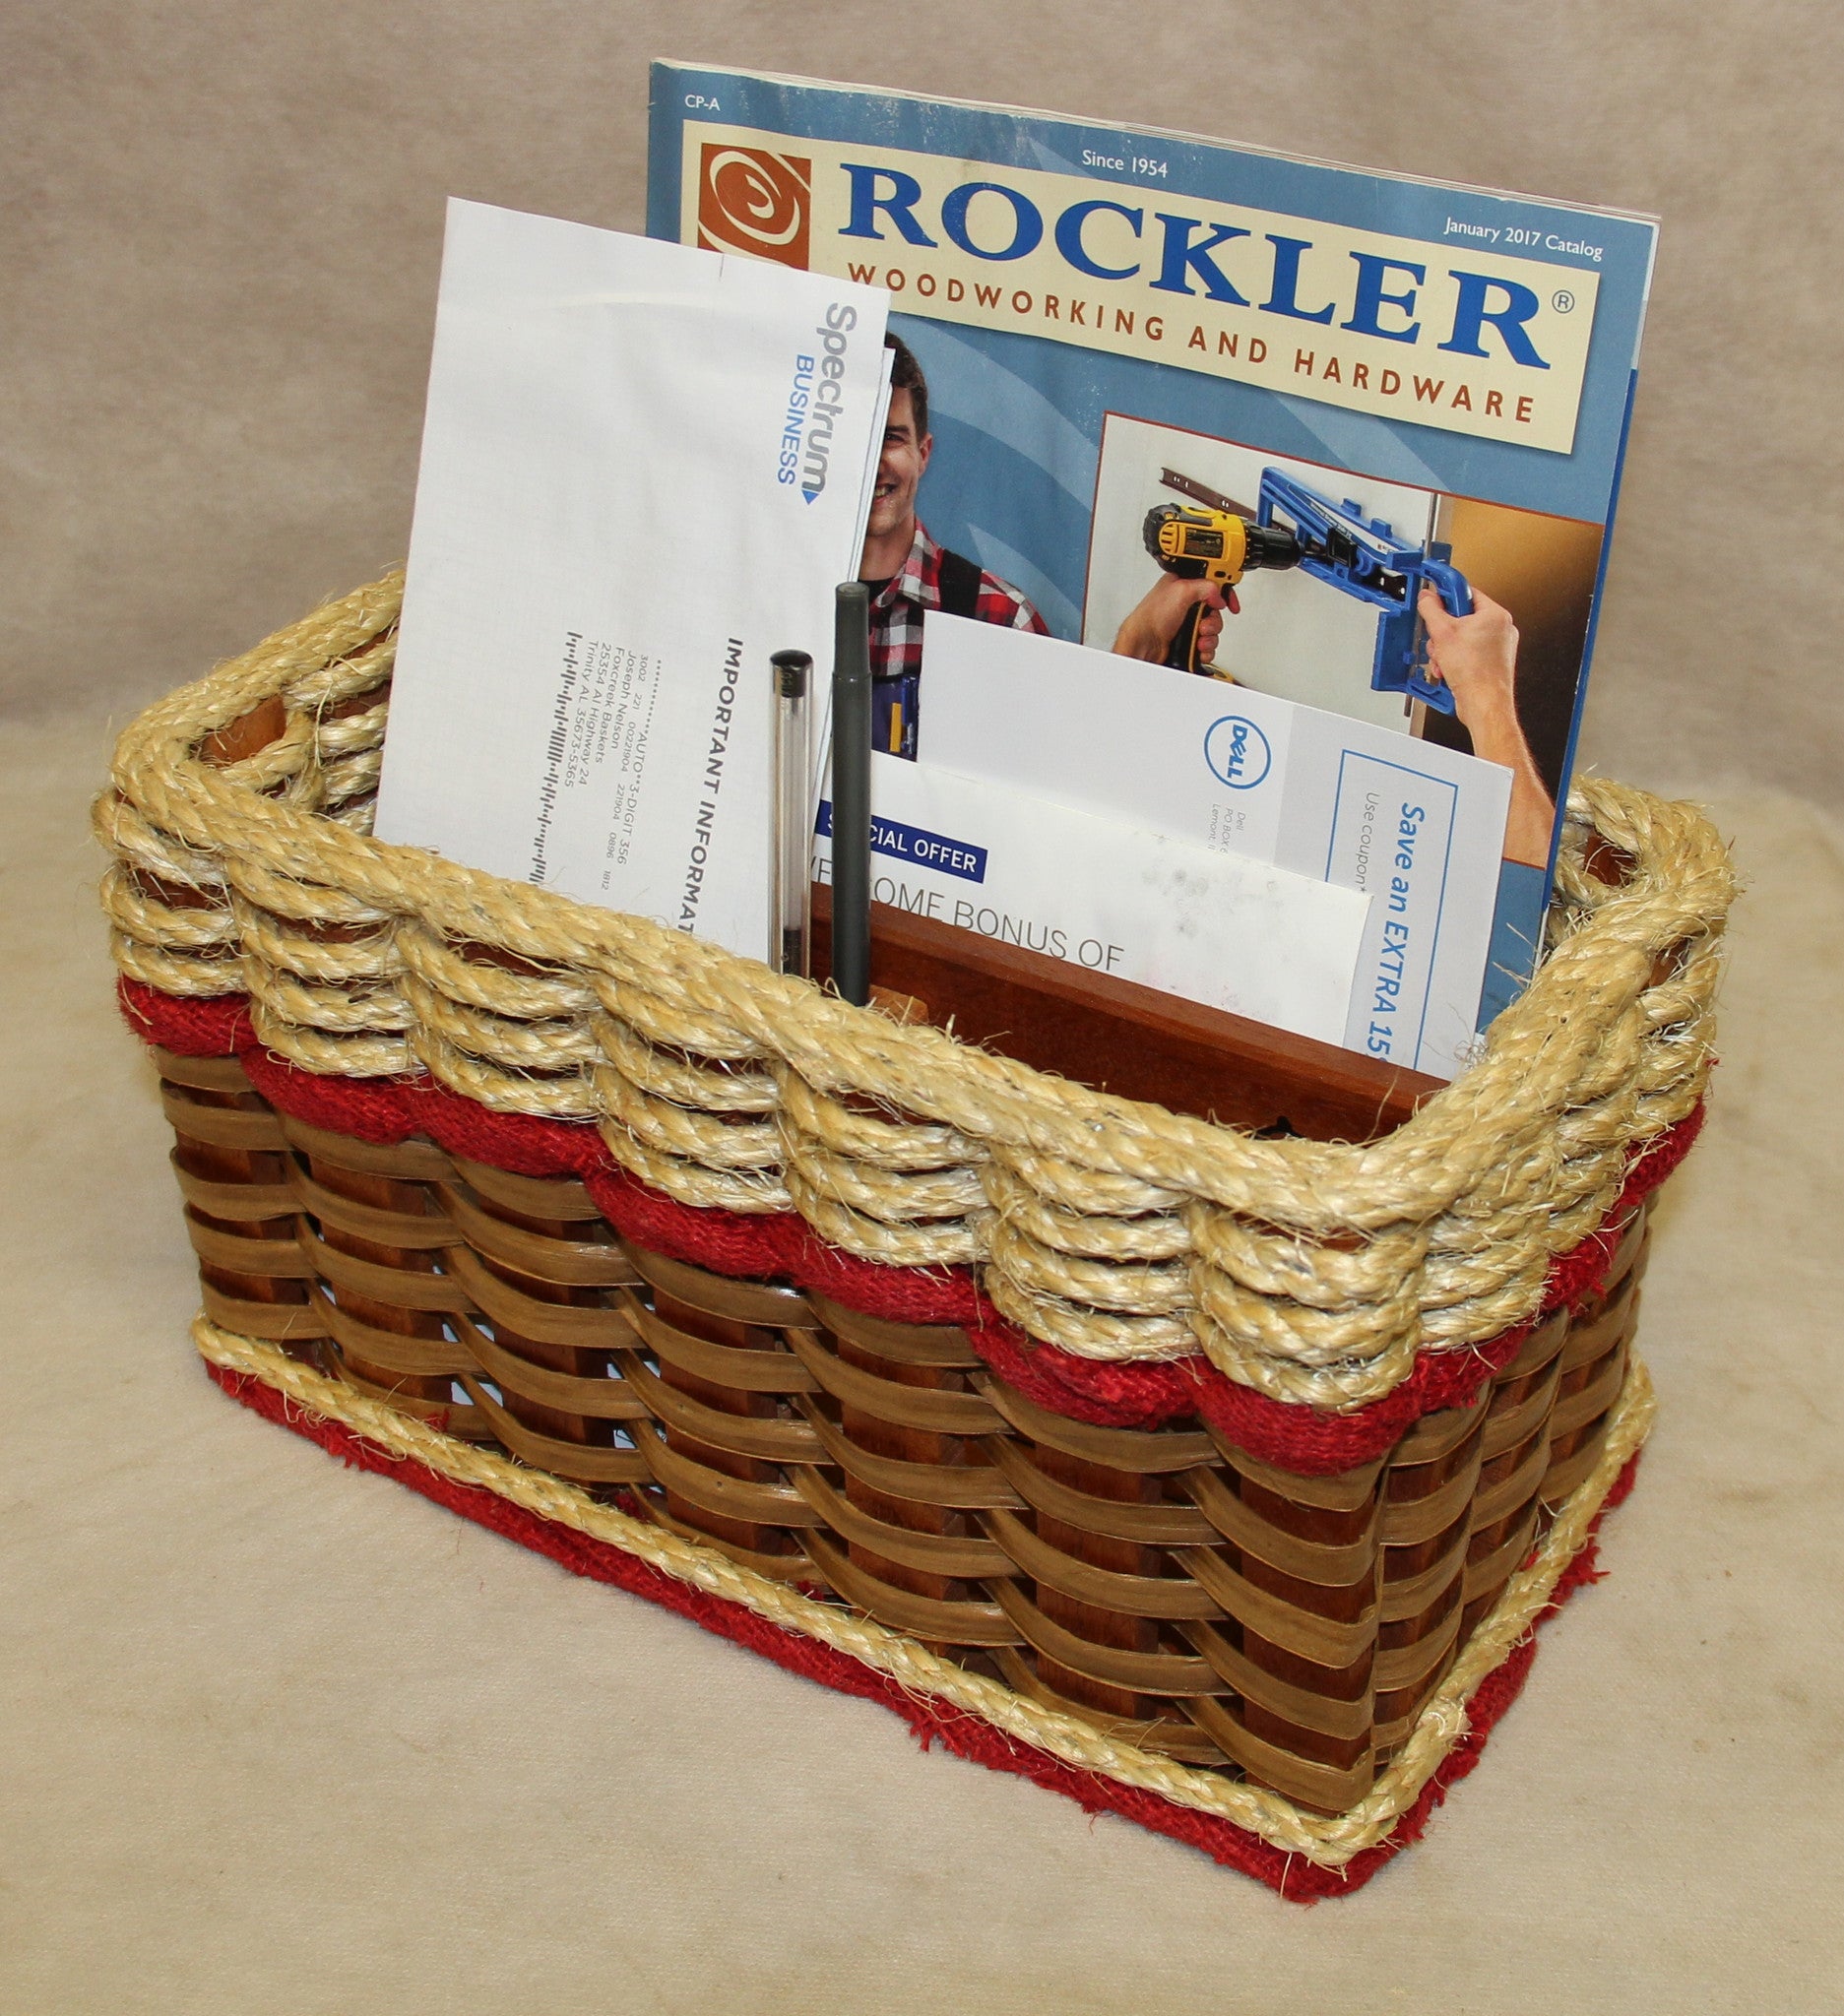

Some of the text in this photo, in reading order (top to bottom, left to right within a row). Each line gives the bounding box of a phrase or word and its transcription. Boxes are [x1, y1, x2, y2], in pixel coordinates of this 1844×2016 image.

[684, 94, 721, 111] CP-A
[1081, 150, 1169, 178] Since 1954
[1443, 217, 1604, 263] January 2017 Catalog
[838, 162, 1552, 370] ROCKLER
[847, 262, 1534, 423] WOODWORKING AND HARDWARE
[778, 354, 815, 485] BUSINESS
[800, 303, 858, 492] Spectrum
[596, 642, 611, 685] 25354
[638, 654, 649, 682] 3002
[564, 641, 600, 788] Trinity AL 35673-5365
[595, 647, 626, 764] Foxcreek Baskets
[610, 650, 637, 749] Joseph Nelson
[632, 692, 642, 710] 221
[704, 638, 744, 794] IMPORTANT
[580, 707, 600, 765] Highway
[621, 722, 636, 772] 00221904
[1227, 724, 1249, 779] DELL
[578, 768, 590, 786] 24
[612, 784, 625, 820] 221904
[1224, 807, 1234, 823] PO
[1363, 791, 1380, 822] Use
[617, 839, 631, 865] 356
[914, 839, 978, 873] OFFER
[1221, 824, 1232, 847] BOX
[1394, 802, 1426, 870] Save
[1388, 876, 1410, 913] an
[954, 900, 1067, 960] BONUS
[1078, 938, 1125, 972] OF
[1371, 919, 1410, 1012] EXTRA
